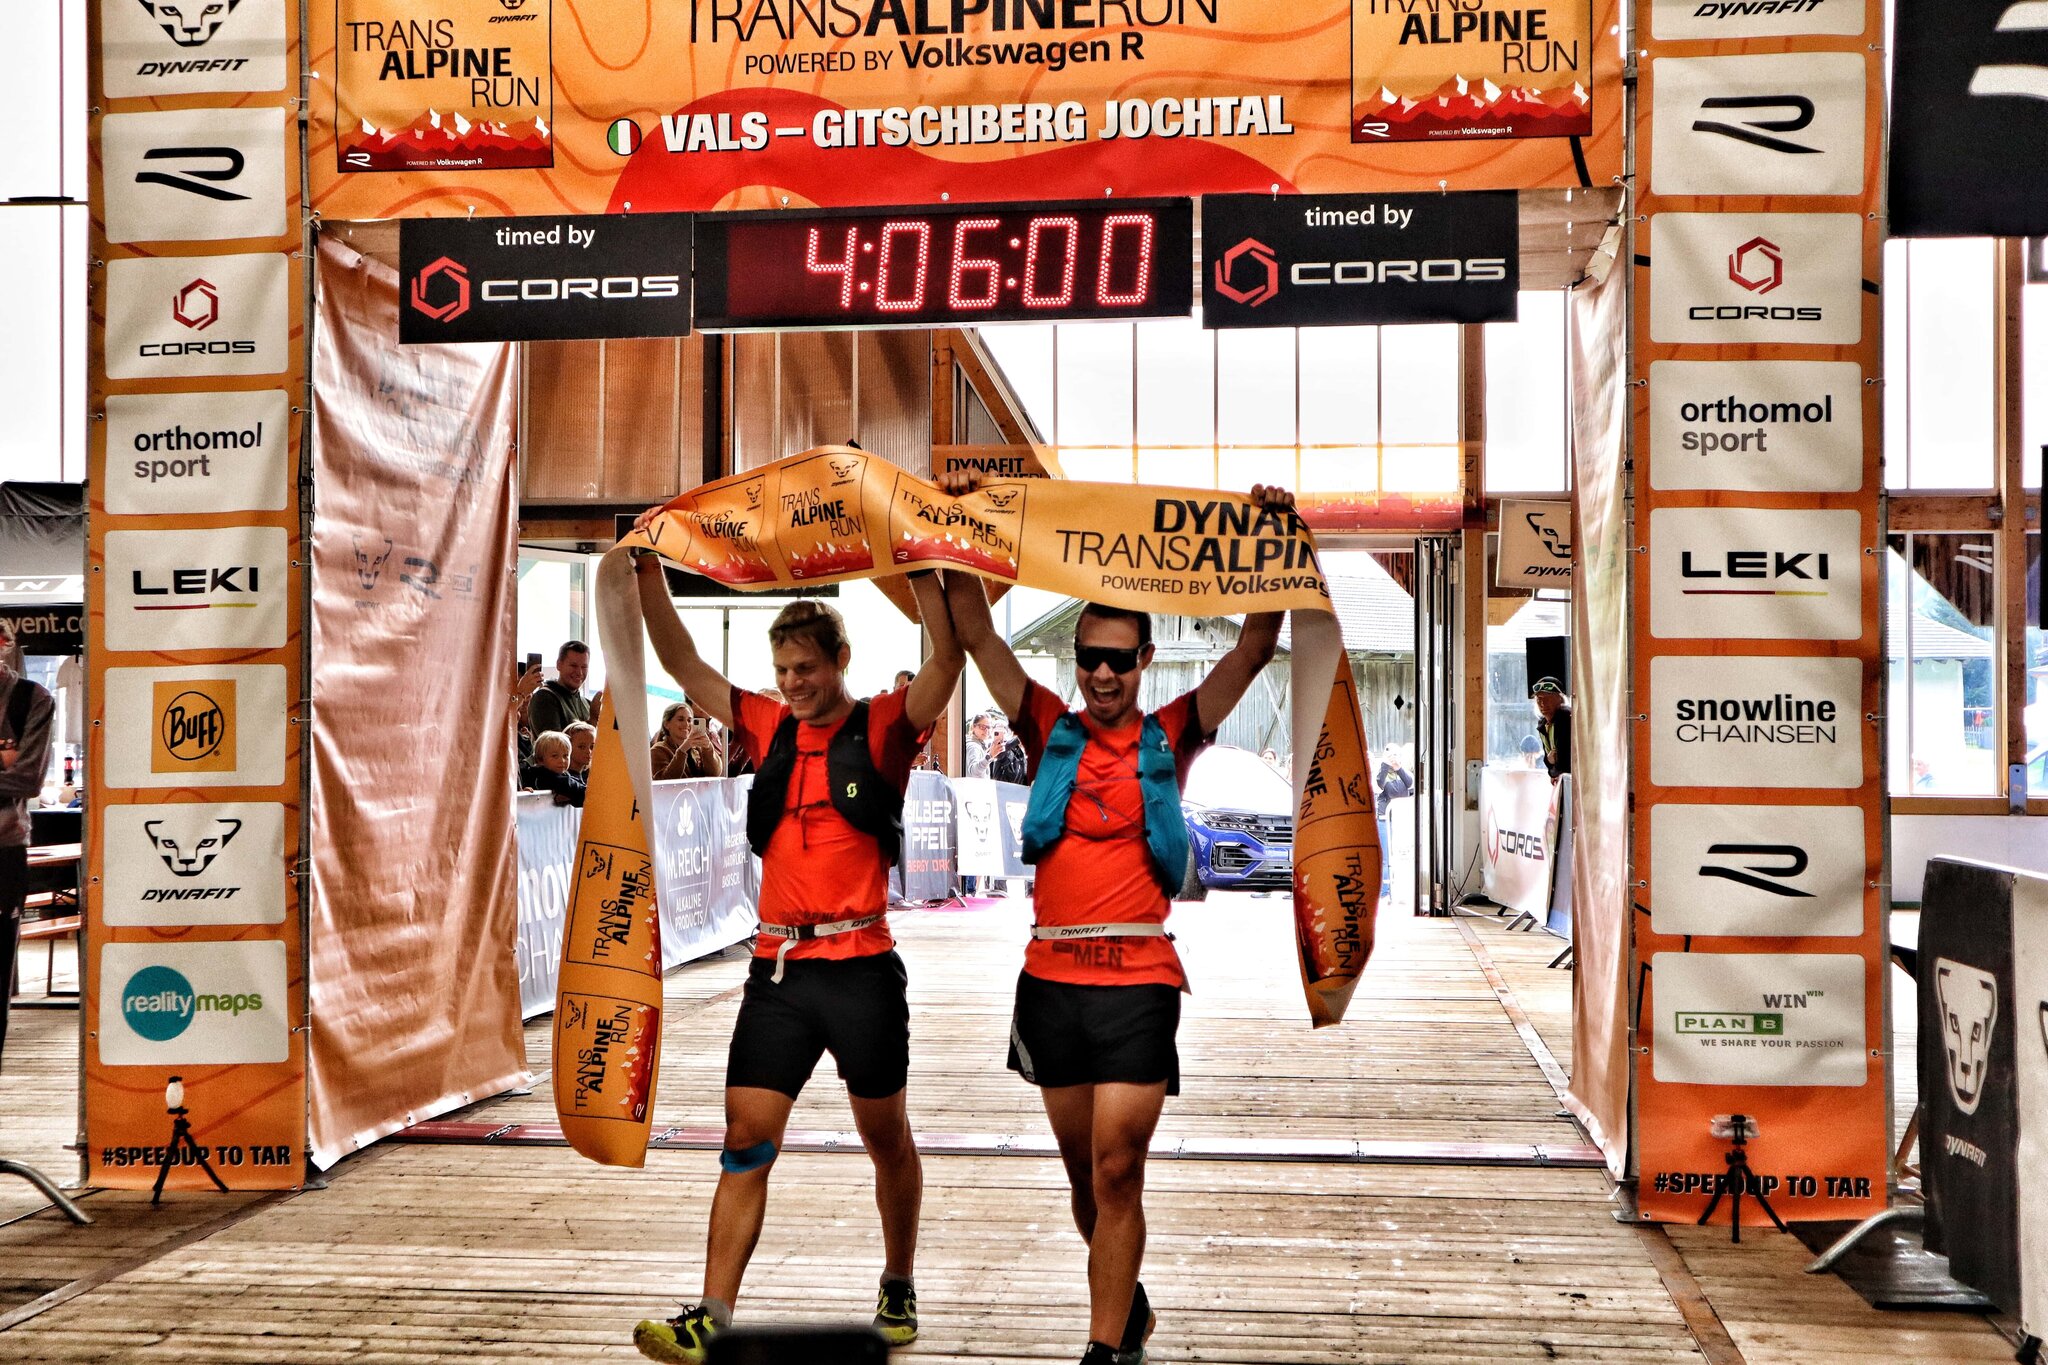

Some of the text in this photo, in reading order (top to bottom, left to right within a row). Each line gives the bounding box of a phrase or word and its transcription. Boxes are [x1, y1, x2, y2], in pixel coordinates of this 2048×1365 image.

[488, 14, 538, 24] DYNAFIT
[1693, 0, 1824, 19] DYNAFIT
[346, 19, 454, 52] TRANS
[1399, 9, 1548, 45] ALPINE
[379, 47, 512, 81] ALPINE
[745, 31, 1145, 75] POWERED BY Volkswagen R
[1503, 40, 1578, 74] RUN
[137, 58, 249, 77] DYNAFIT
[471, 77, 539, 108] RUN
[661, 111, 769, 153] VALS
[812, 100, 1087, 149] GITSCHBERG
[1098, 95, 1294, 140] JOCHTAL
[1461, 126, 1506, 137] Volkswagen
[436, 158, 477, 167] Volkswagen
[1304, 203, 1413, 229] timed by
[496, 225, 596, 249] timed by
[1290, 258, 1506, 286] COROS
[481, 275, 679, 302] COROS
[1688, 305, 1822, 321] COROS
[139, 340, 255, 357] COROS
[1680, 394, 1832, 424] orthomol
[134, 422, 262, 451] orthomol
[1681, 427, 1767, 457] sport
[135, 455, 210, 482] sport
[946, 458, 1025, 473] DYNAFIT
[781, 487, 820, 513] TRANS
[791, 499, 846, 528] ALPINE
[901, 488, 963, 517] TRANS
[701, 521, 748, 538] ALPINE
[829, 515, 862, 538] RUN
[917, 509, 997, 534] ALPINE
[972, 528, 1013, 552] RUN
[1681, 551, 1829, 580] LEKI
[133, 567, 258, 595] LEKI
[1101, 575, 1183, 594] POWERED
[1189, 581, 1211, 595] BY
[1676, 693, 1837, 722] snowline
[1676, 724, 1837, 744] CHAINSEN
[1499, 829, 1544, 860] COROS
[636, 860, 651, 899] RUN
[1345, 852, 1368, 918] TRANS
[141, 887, 241, 903] DYNAFIT
[612, 871, 639, 945] ALPINE
[676, 893, 702, 913] ALKALINE
[675, 910, 704, 933] PRODUCTS
[1333, 874, 1361, 953] ALPINE
[592, 899, 618, 959] TRANS
[1060, 926, 1108, 937] DYNAFIT
[1074, 944, 1122, 967] MEN
[1331, 928, 1352, 969] RUN
[1763, 994, 1807, 1008] WIN
[610, 1005, 632, 1044] RUN
[1684, 1018, 1776, 1030] PLAN B
[588, 1018, 614, 1094] ALPINE
[1700, 1039, 1844, 1048] WE SHARE YOUR PASSION
[575, 1049, 592, 1110] TRANS
[216, 1146, 245, 1167] TO
[250, 1145, 291, 1168] TAR
[1786, 1175, 1818, 1198] TO
[1824, 1176, 1872, 1199] TAR
